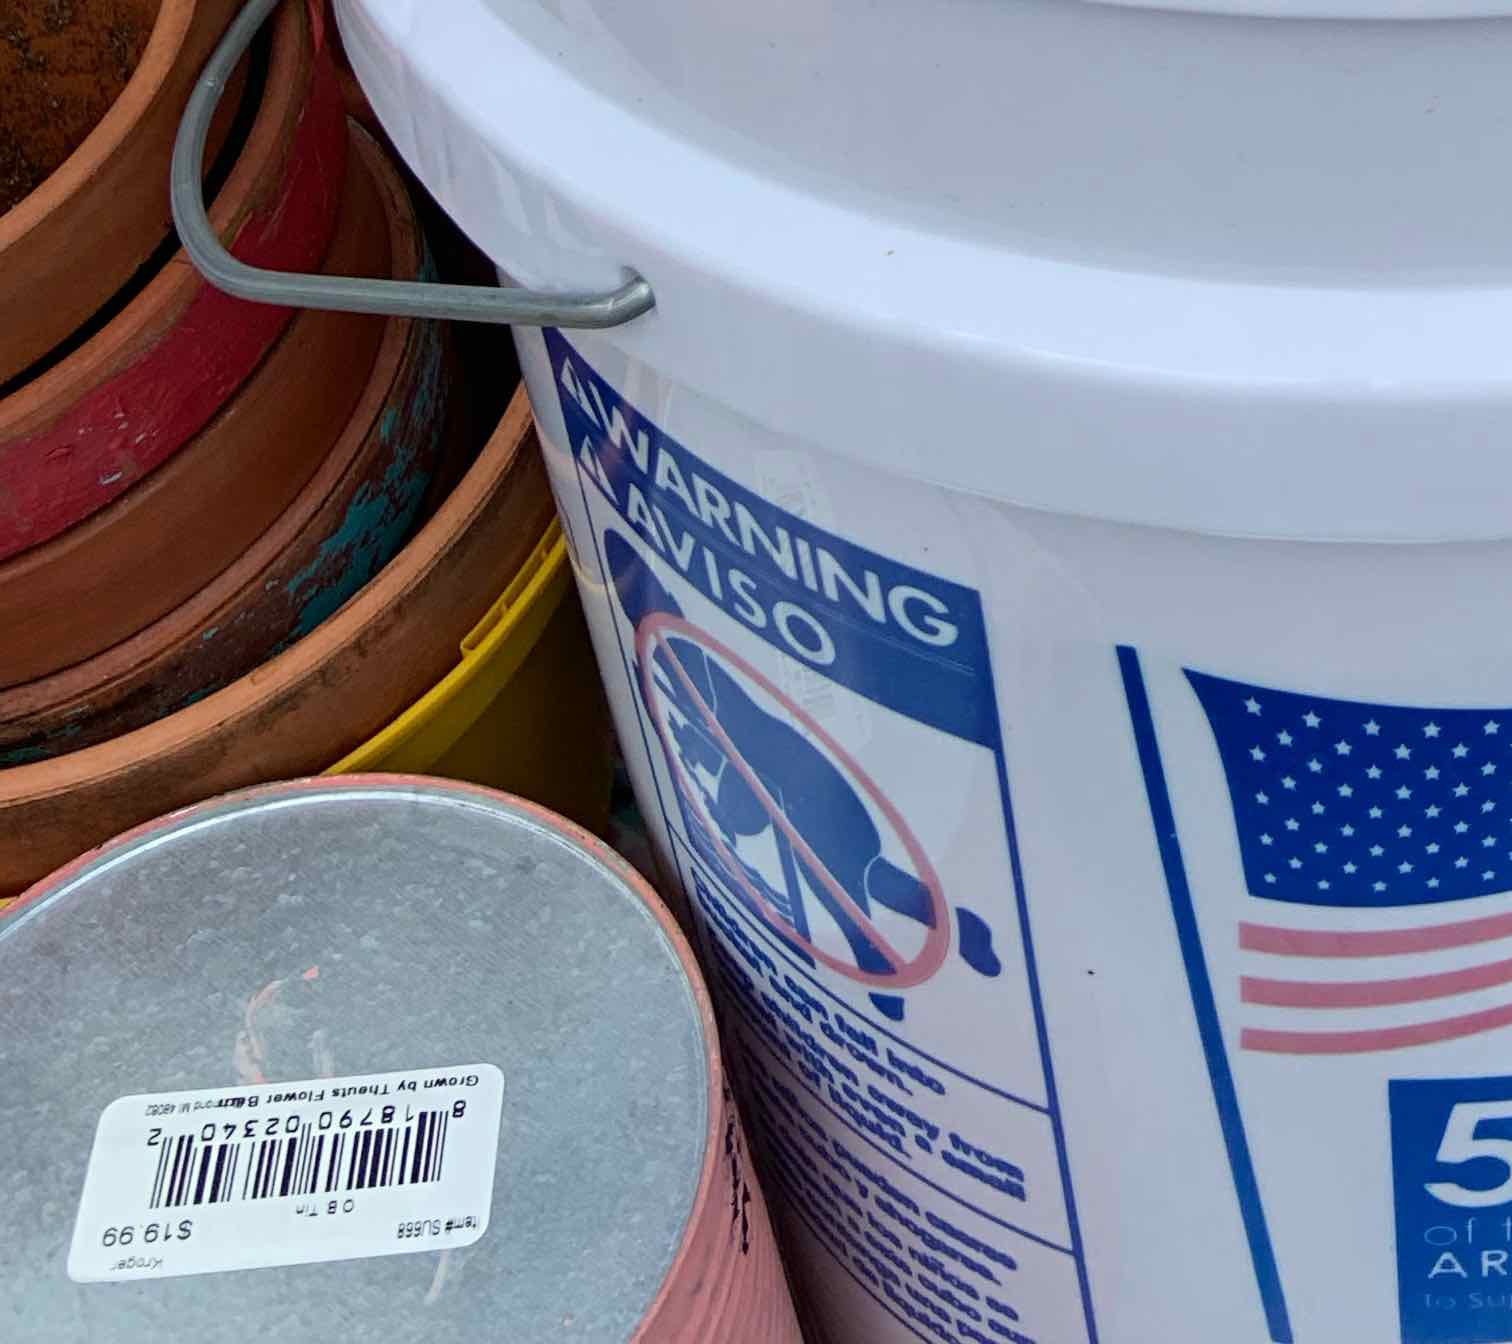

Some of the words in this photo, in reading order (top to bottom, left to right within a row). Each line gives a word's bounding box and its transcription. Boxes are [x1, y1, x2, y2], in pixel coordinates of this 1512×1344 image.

[588, 379, 959, 648] WARNING
[626, 482, 836, 667] AVISO
[397, 1079, 417, 1093] by
[424, 1074, 480, 1090] Grown
[266, 1089, 325, 1105] Flower
[452, 1100, 466, 1118] 8
[201, 1115, 299, 1142] 02340
[318, 1104, 412, 1130] 18790
[147, 1128, 162, 1146] 2
[102, 1219, 193, 1247] $19.99
[1423, 1216, 1478, 1247] of
